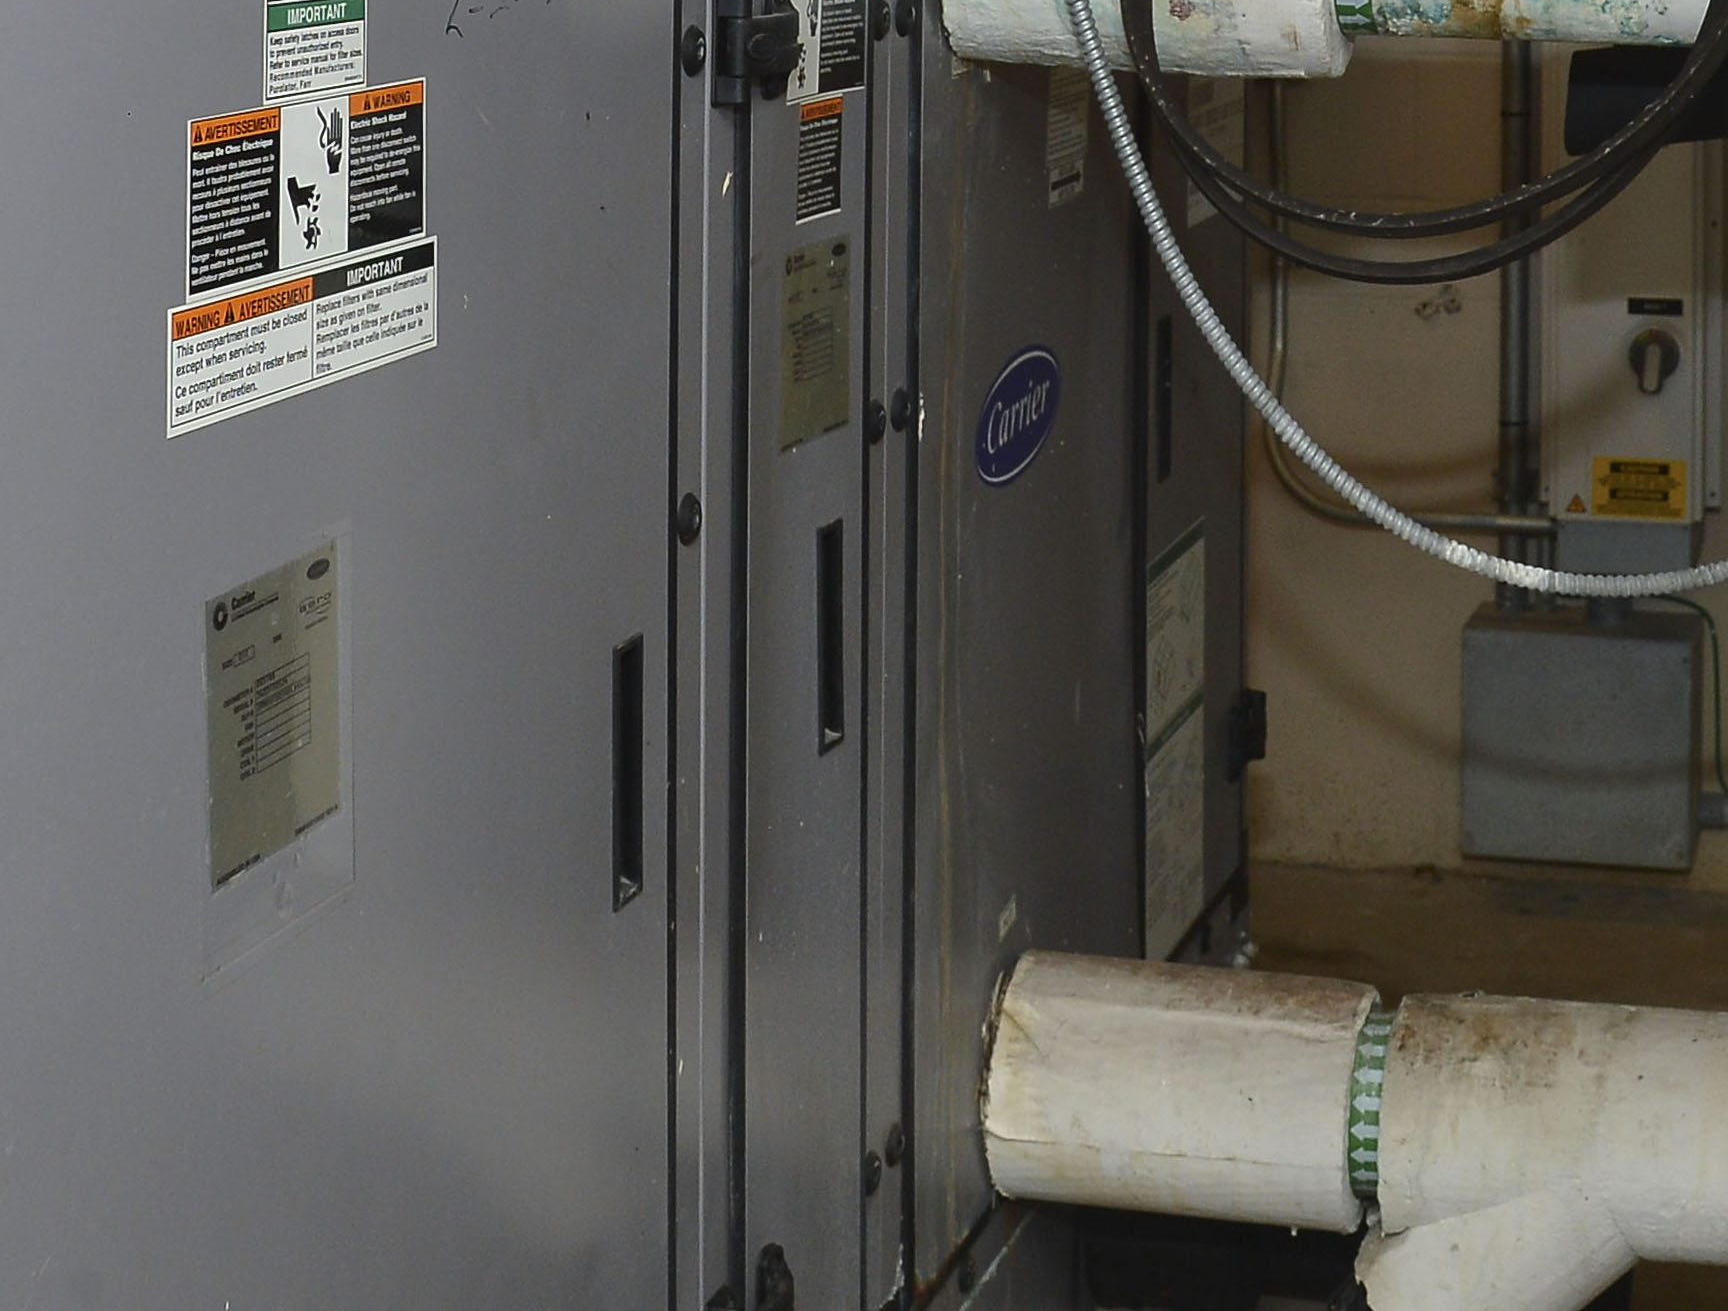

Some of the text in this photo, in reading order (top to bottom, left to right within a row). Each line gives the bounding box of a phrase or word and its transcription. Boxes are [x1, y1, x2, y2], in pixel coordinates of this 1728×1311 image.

[287, 3, 347, 25] IMPORTANT
[374, 90, 410, 109] WARNING
[205, 115, 277, 141] AVERTISSEMENT
[346, 256, 403, 286] IMPORTANT
[176, 285, 310, 336] WARNING AVERTISSEMENT
[316, 274, 428, 314] Replace filters with same dimensional
[316, 303, 382, 330] size as given on filter.
[316, 326, 349, 344] Remplacer
[351, 323, 359, 333] les
[361, 318, 378, 330] filtres
[380, 314, 390, 326] par
[415, 304, 423, 313] de
[424, 301, 429, 311] la
[176, 309, 308, 358] This compartment must be closed
[352, 338, 364, 349] que
[407, 320, 416, 330] sur
[418, 318, 424, 326] le
[176, 341, 267, 377] except when servicing.
[176, 345, 308, 398] Ce compartiment doit rester fermé
[176, 400, 193, 417] sauf
[195, 395, 214, 413] pour
[986, 380, 1049, 455] Carrier
